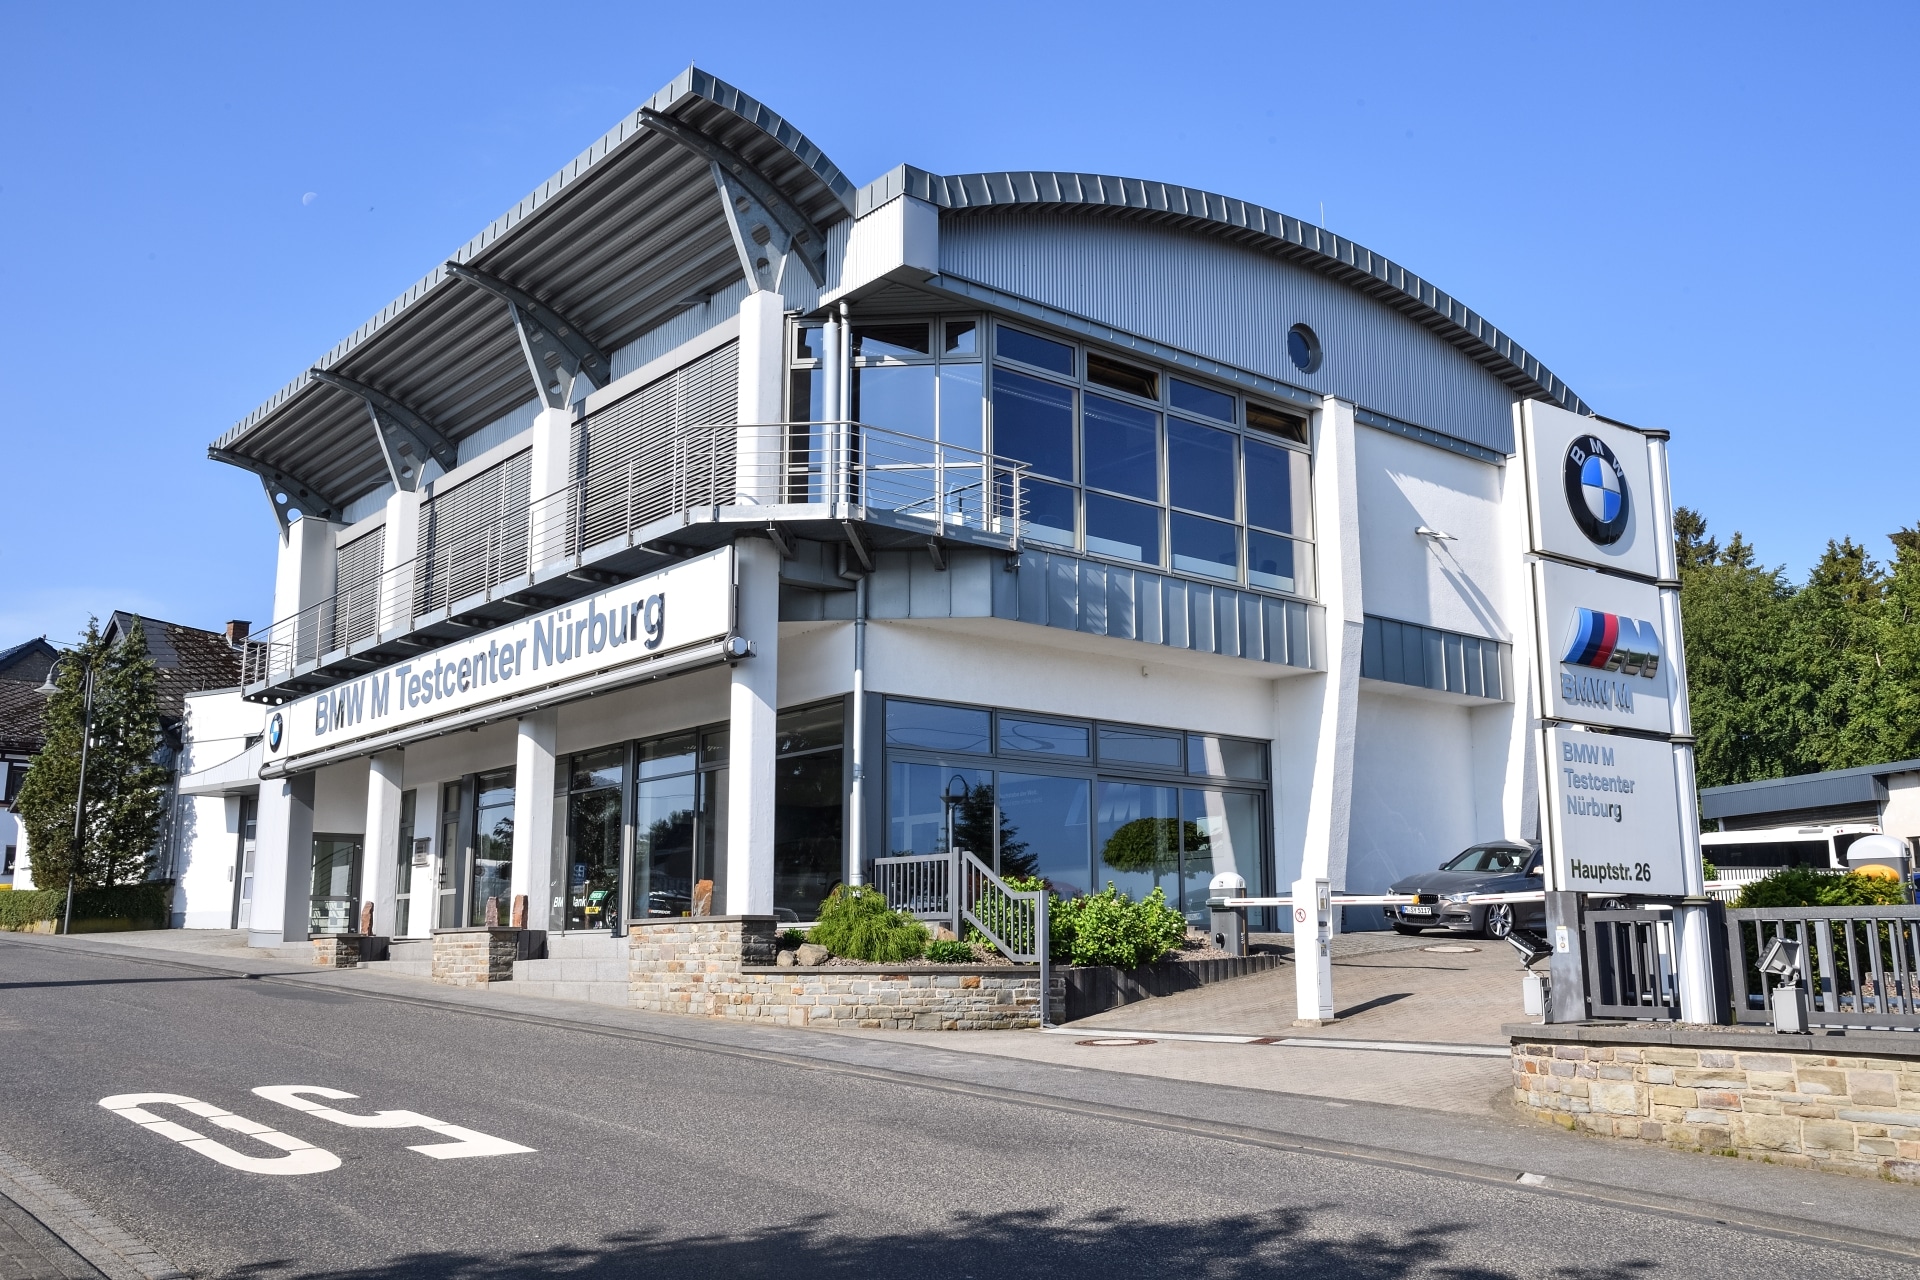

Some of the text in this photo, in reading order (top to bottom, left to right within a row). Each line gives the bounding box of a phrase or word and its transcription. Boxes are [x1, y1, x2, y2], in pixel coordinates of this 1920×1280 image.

[1570, 437, 1624, 478] BMW
[315, 592, 665, 736] BMW M Testcenter Nürburg
[1560, 672, 1632, 709] BMW M
[1562, 741, 1615, 767] BMW M
[1563, 767, 1636, 794] Testcenter
[1566, 794, 1623, 823] Nürburg
[1570, 858, 1652, 884] Hauptstr. 26
[98, 1084, 539, 1176] 50
